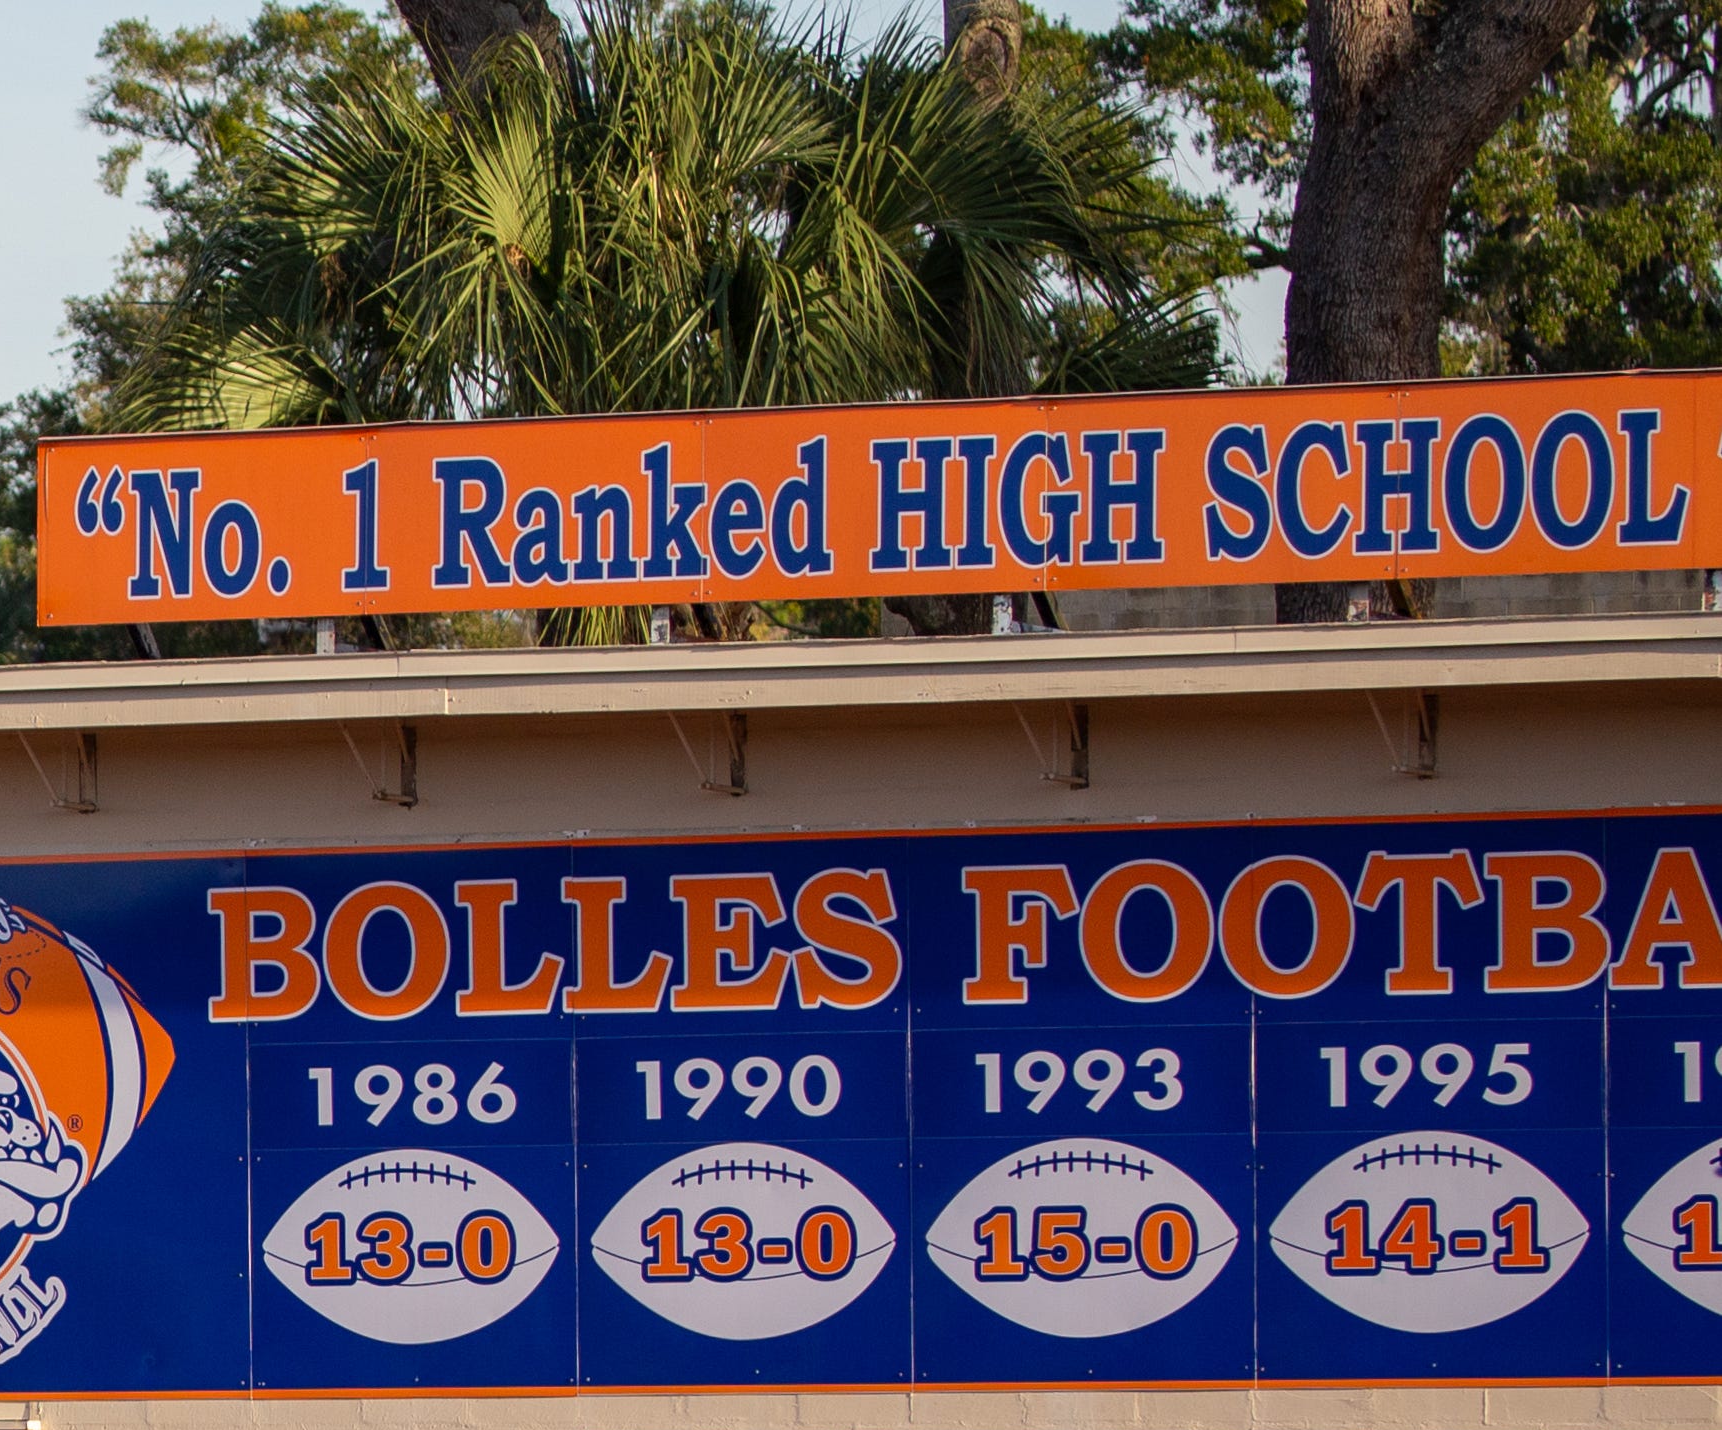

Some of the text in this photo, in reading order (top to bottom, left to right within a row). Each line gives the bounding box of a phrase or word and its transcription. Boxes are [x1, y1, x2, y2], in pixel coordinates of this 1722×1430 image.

[342, 457, 391, 592] 1
[431, 434, 834, 590] Ranked
[868, 426, 1166, 573] HIGH
[1202, 408, 1691, 562] SCHOOL
[207, 847, 1722, 1022] BOLLES FOOTBA
[308, 1061, 518, 1127] 1986
[636, 1054, 842, 1121] 1990
[974, 1047, 1183, 1114] 1993
[1319, 1042, 1533, 1109] 1995
[305, 1209, 516, 1286] 13-0
[641, 1204, 857, 1282] 13-0
[974, 1202, 1197, 1282] 15-0
[1325, 1197, 1549, 1277] 14-1
